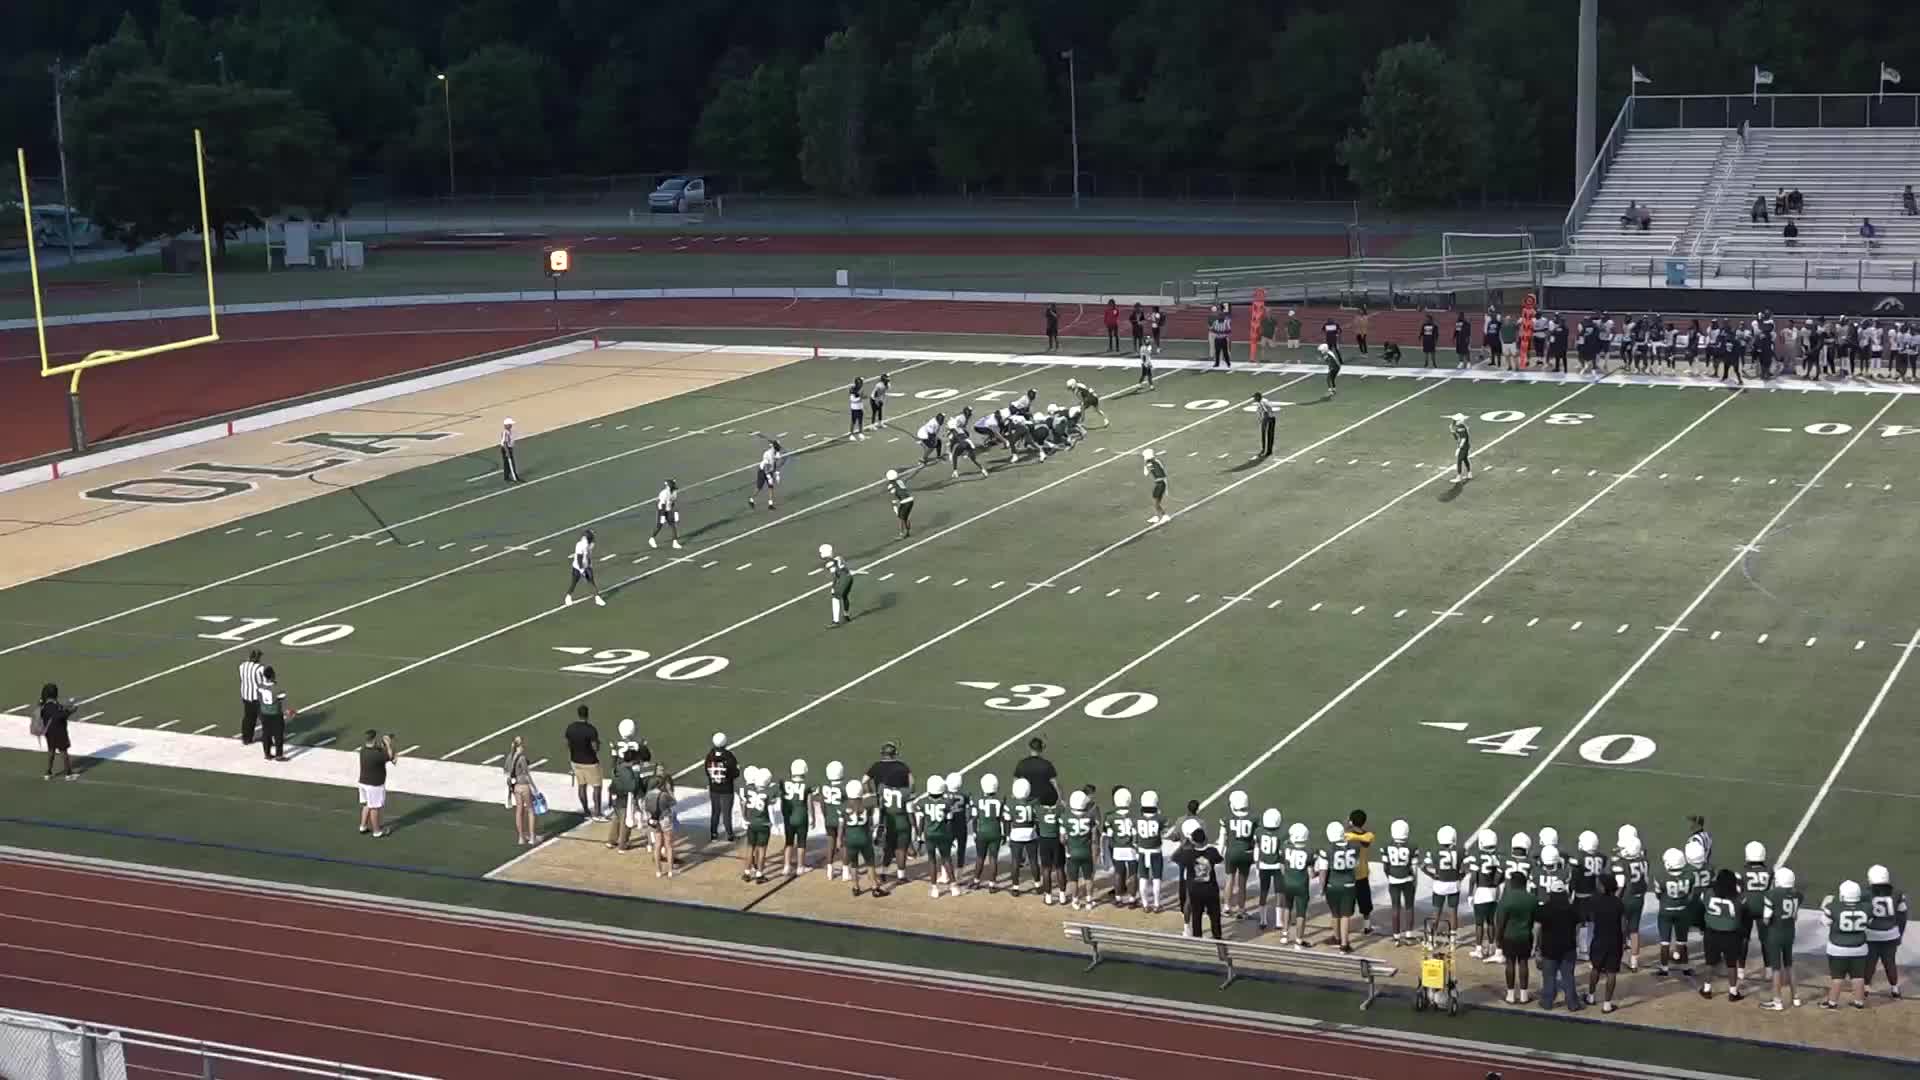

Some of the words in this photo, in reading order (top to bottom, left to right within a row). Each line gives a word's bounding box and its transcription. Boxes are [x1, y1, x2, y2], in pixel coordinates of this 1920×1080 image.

[80, 431, 462, 504] OLA
[198, 617, 355, 646] 10
[559, 648, 730, 680] 20
[984, 683, 1159, 719] 30
[1467, 726, 1657, 765] 40
[785, 781, 806, 800] 94
[925, 803, 946, 822] 46
[978, 799, 1002, 817] 47
[1015, 805, 1033, 823] 31
[1067, 818, 1091, 836] 35
[1229, 819, 1253, 838] 40
[1260, 834, 1278, 854] 81
[1285, 847, 1308, 870] 48
[1333, 849, 1357, 870] 66
[1387, 845, 1410, 866] 89
[1438, 850, 1457, 870] 21
[1629, 860, 1649, 883] 54
[1746, 871, 1770, 891] 29
[1707, 897, 1736, 918] 57
[1781, 897, 1800, 919] 91
[1839, 910, 1867, 932] 62
